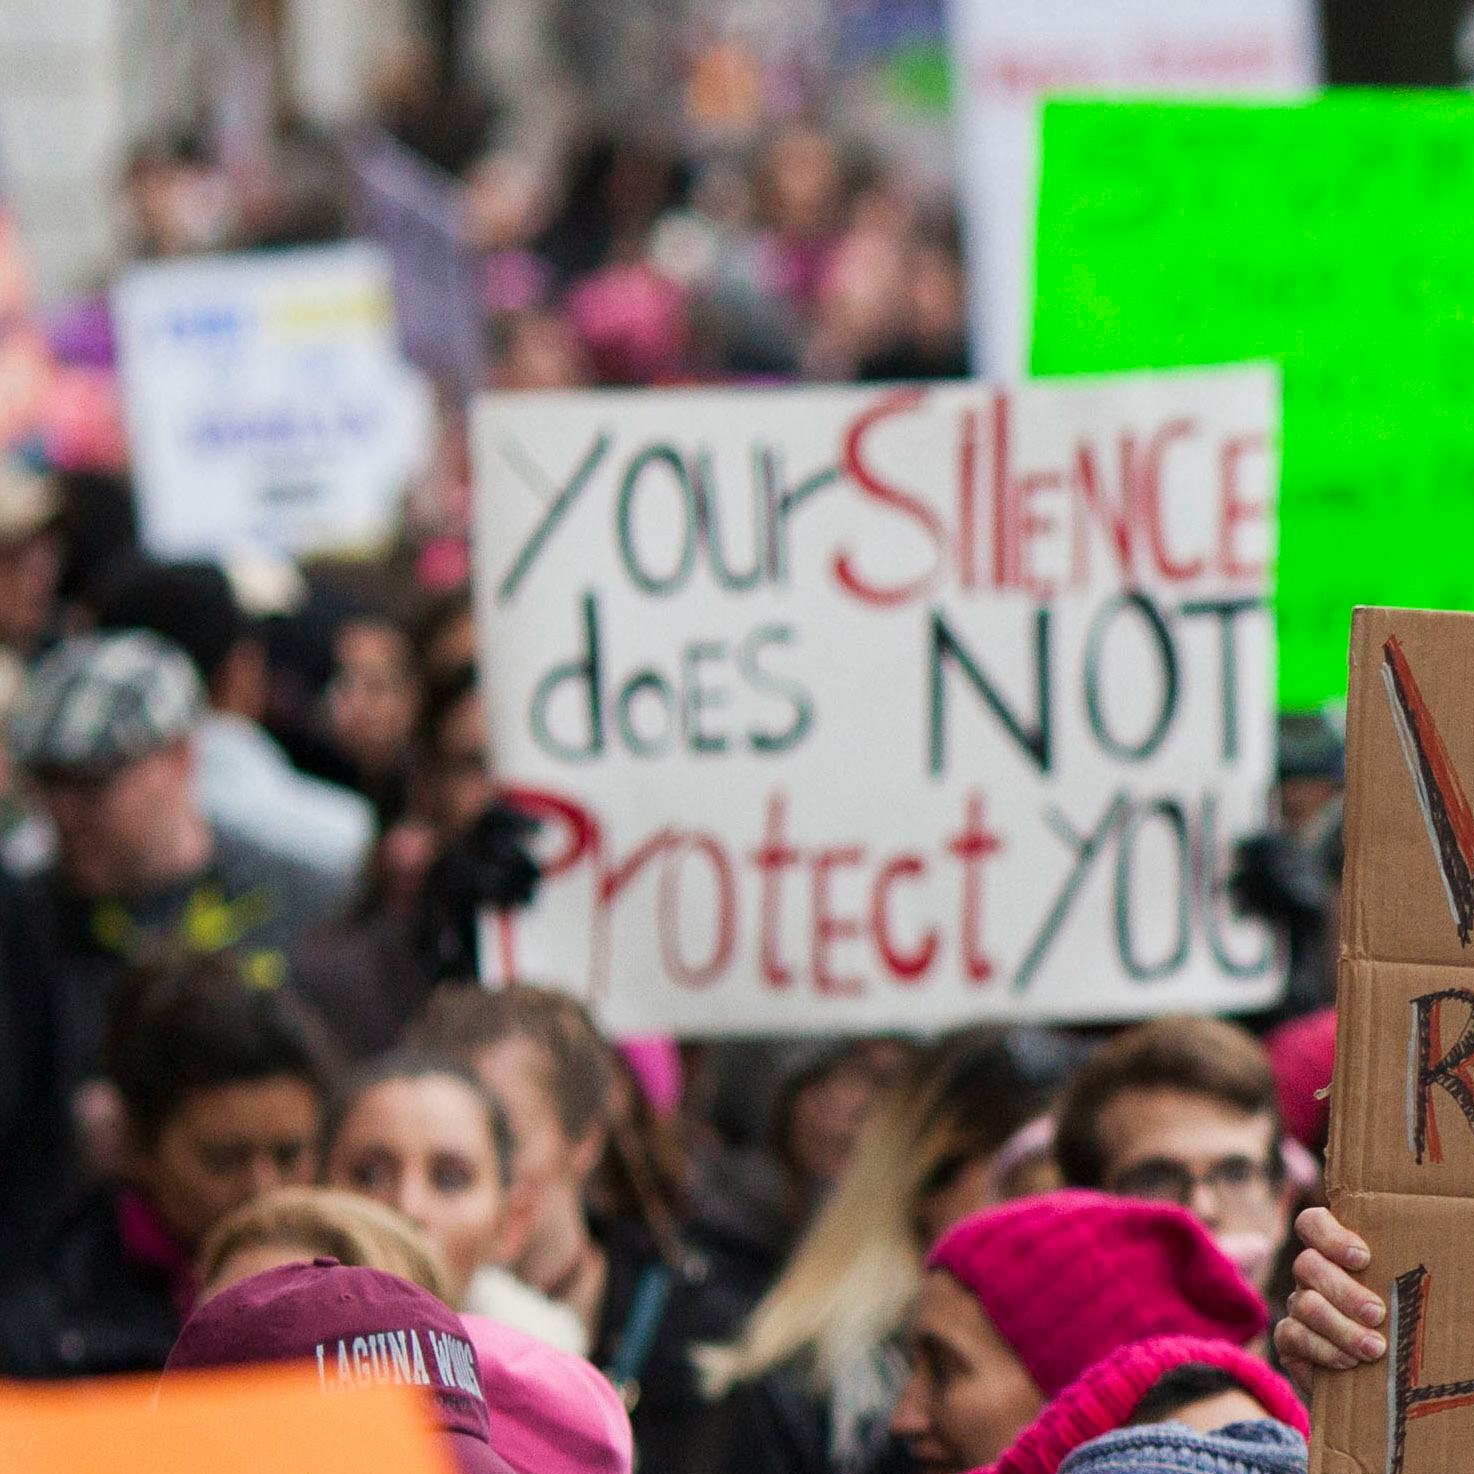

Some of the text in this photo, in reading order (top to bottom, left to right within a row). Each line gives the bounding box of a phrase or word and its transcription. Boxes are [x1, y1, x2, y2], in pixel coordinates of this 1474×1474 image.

[926, 588, 1268, 778] NOT
[1010, 788, 1276, 998] YOU
[315, 1328, 431, 1394] LAGUNA
